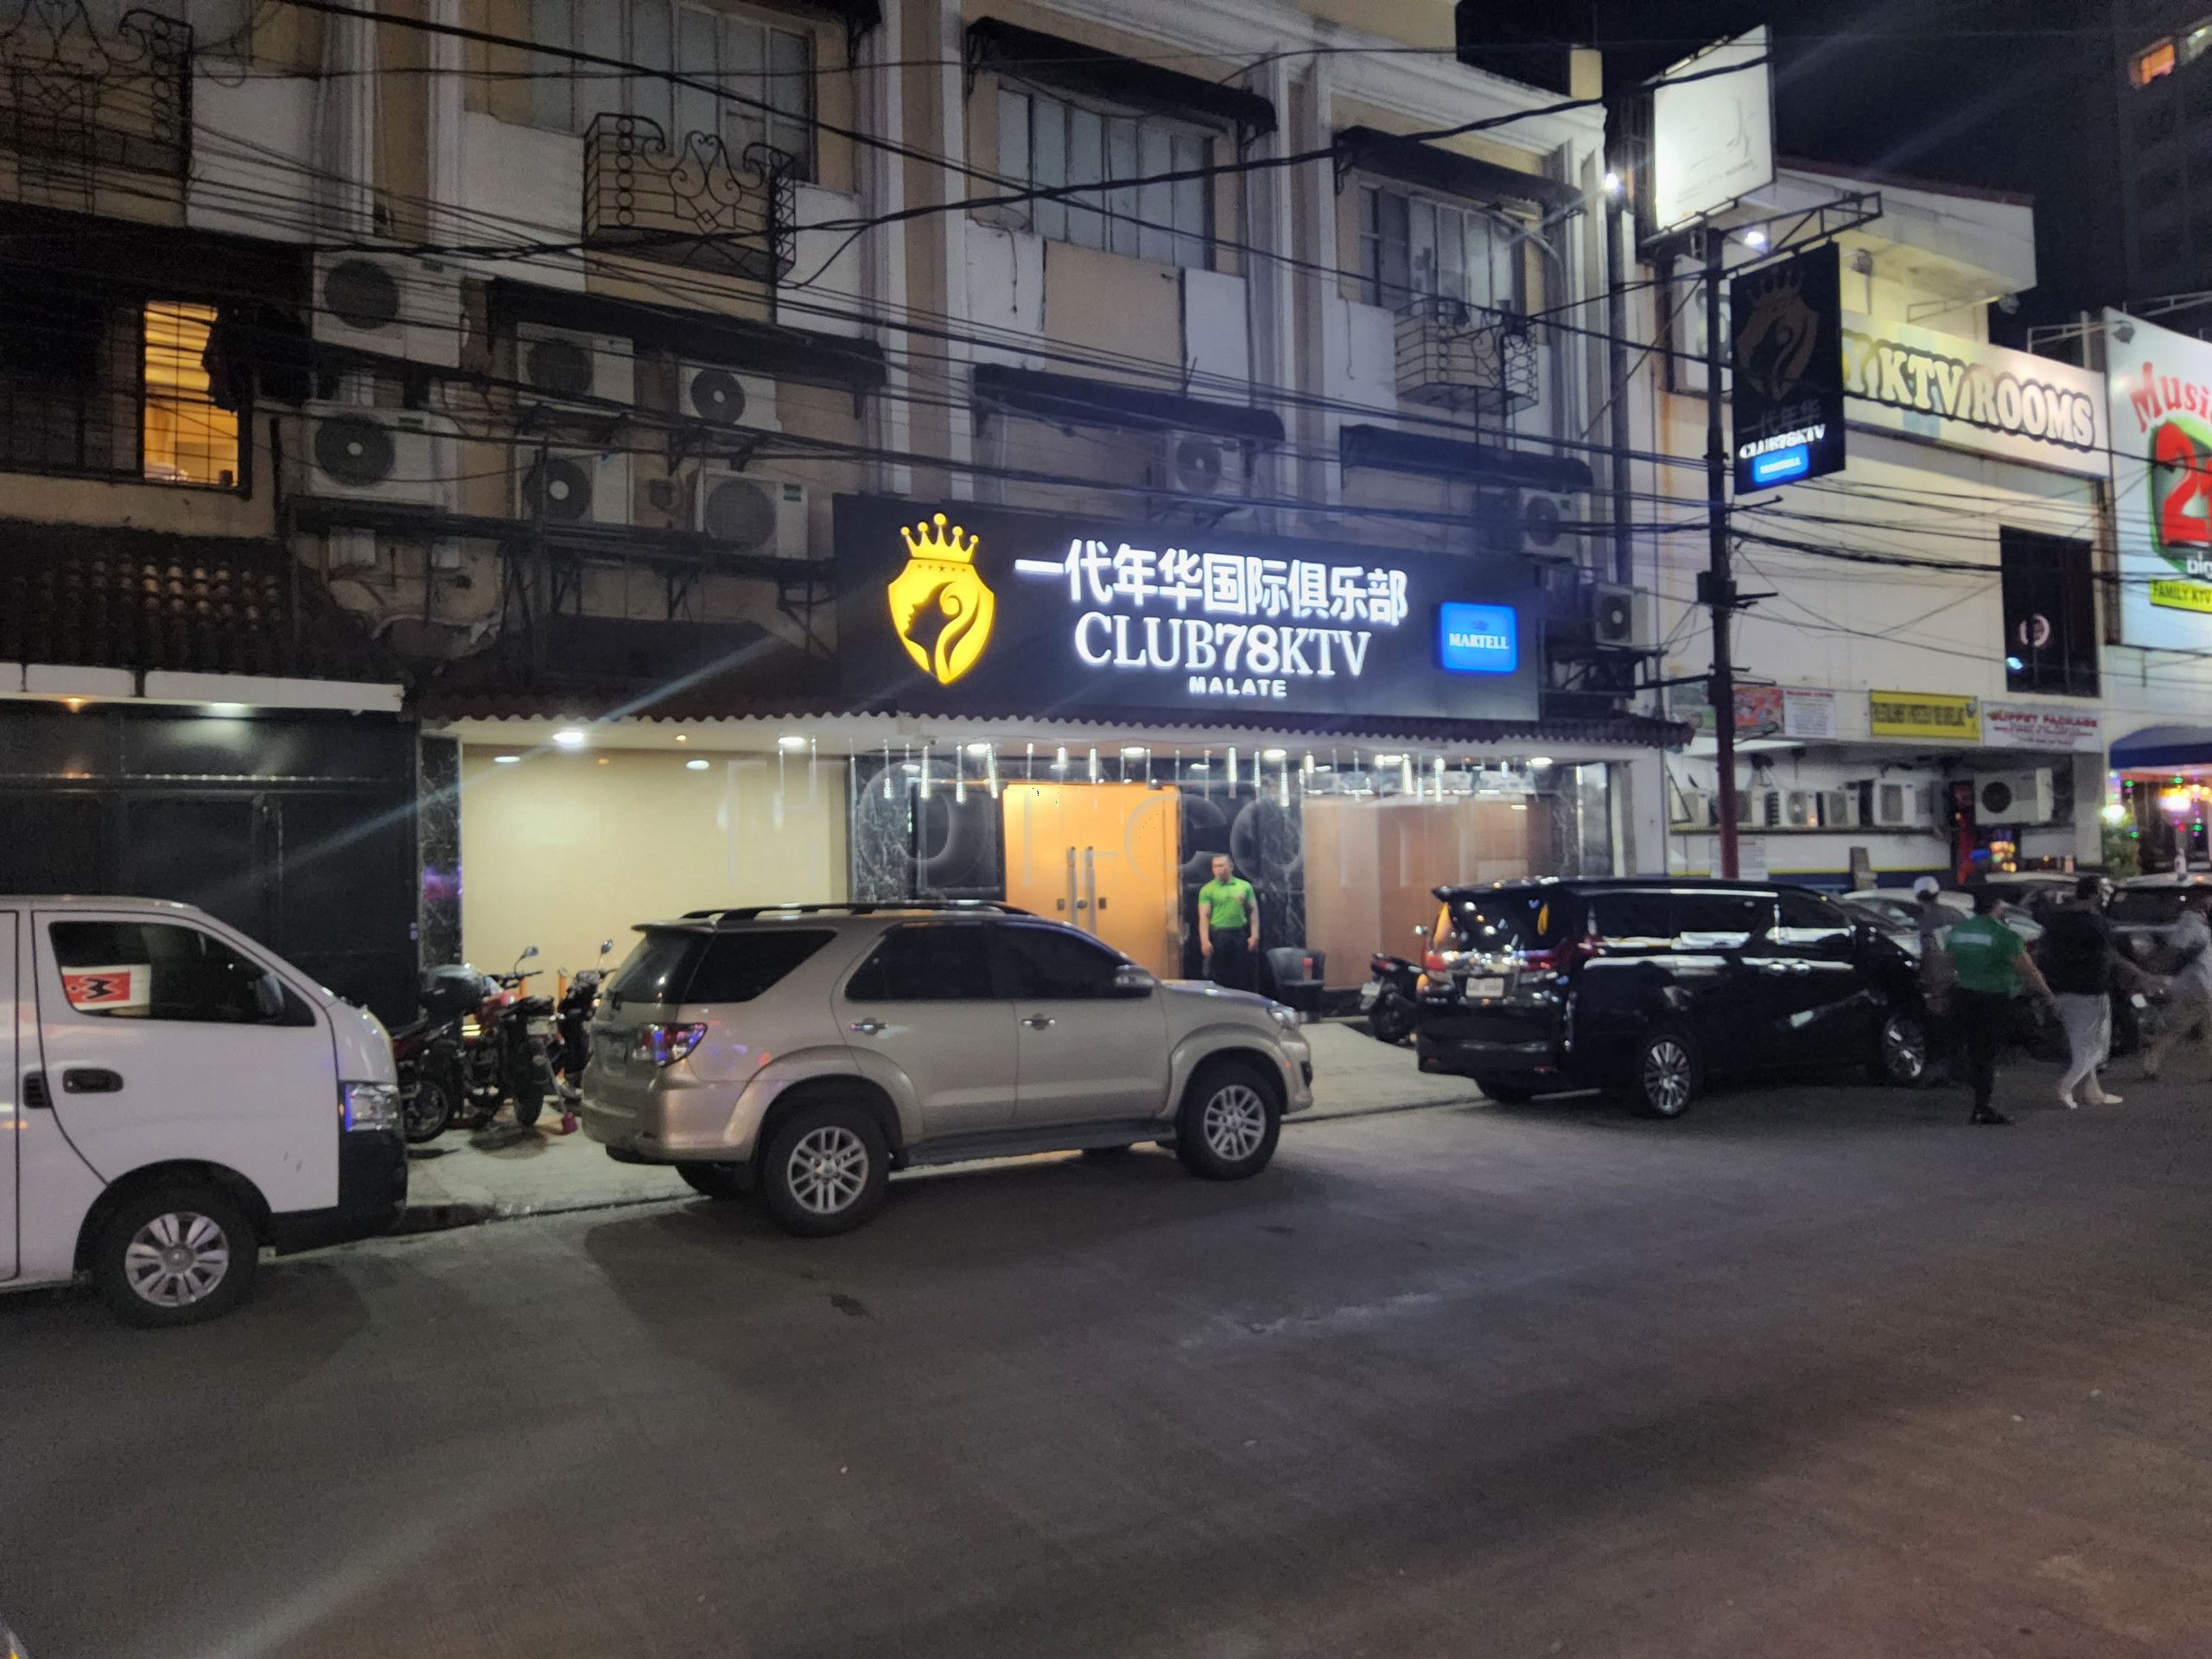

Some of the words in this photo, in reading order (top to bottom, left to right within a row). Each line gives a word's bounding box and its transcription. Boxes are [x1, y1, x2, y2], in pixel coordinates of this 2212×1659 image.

[1875, 338, 1967, 421] KTV
[1969, 362, 2094, 454] ROOMS
[2129, 361, 2212, 433] Musi
[1014, 538, 1408, 626] 一代年华国际俱乐部
[2153, 580, 2188, 601] FAMILY
[1074, 610, 1372, 677] CLUB78KTV
[1448, 632, 1510, 650] MARTELL
[1188, 676, 1288, 698] MALATE
